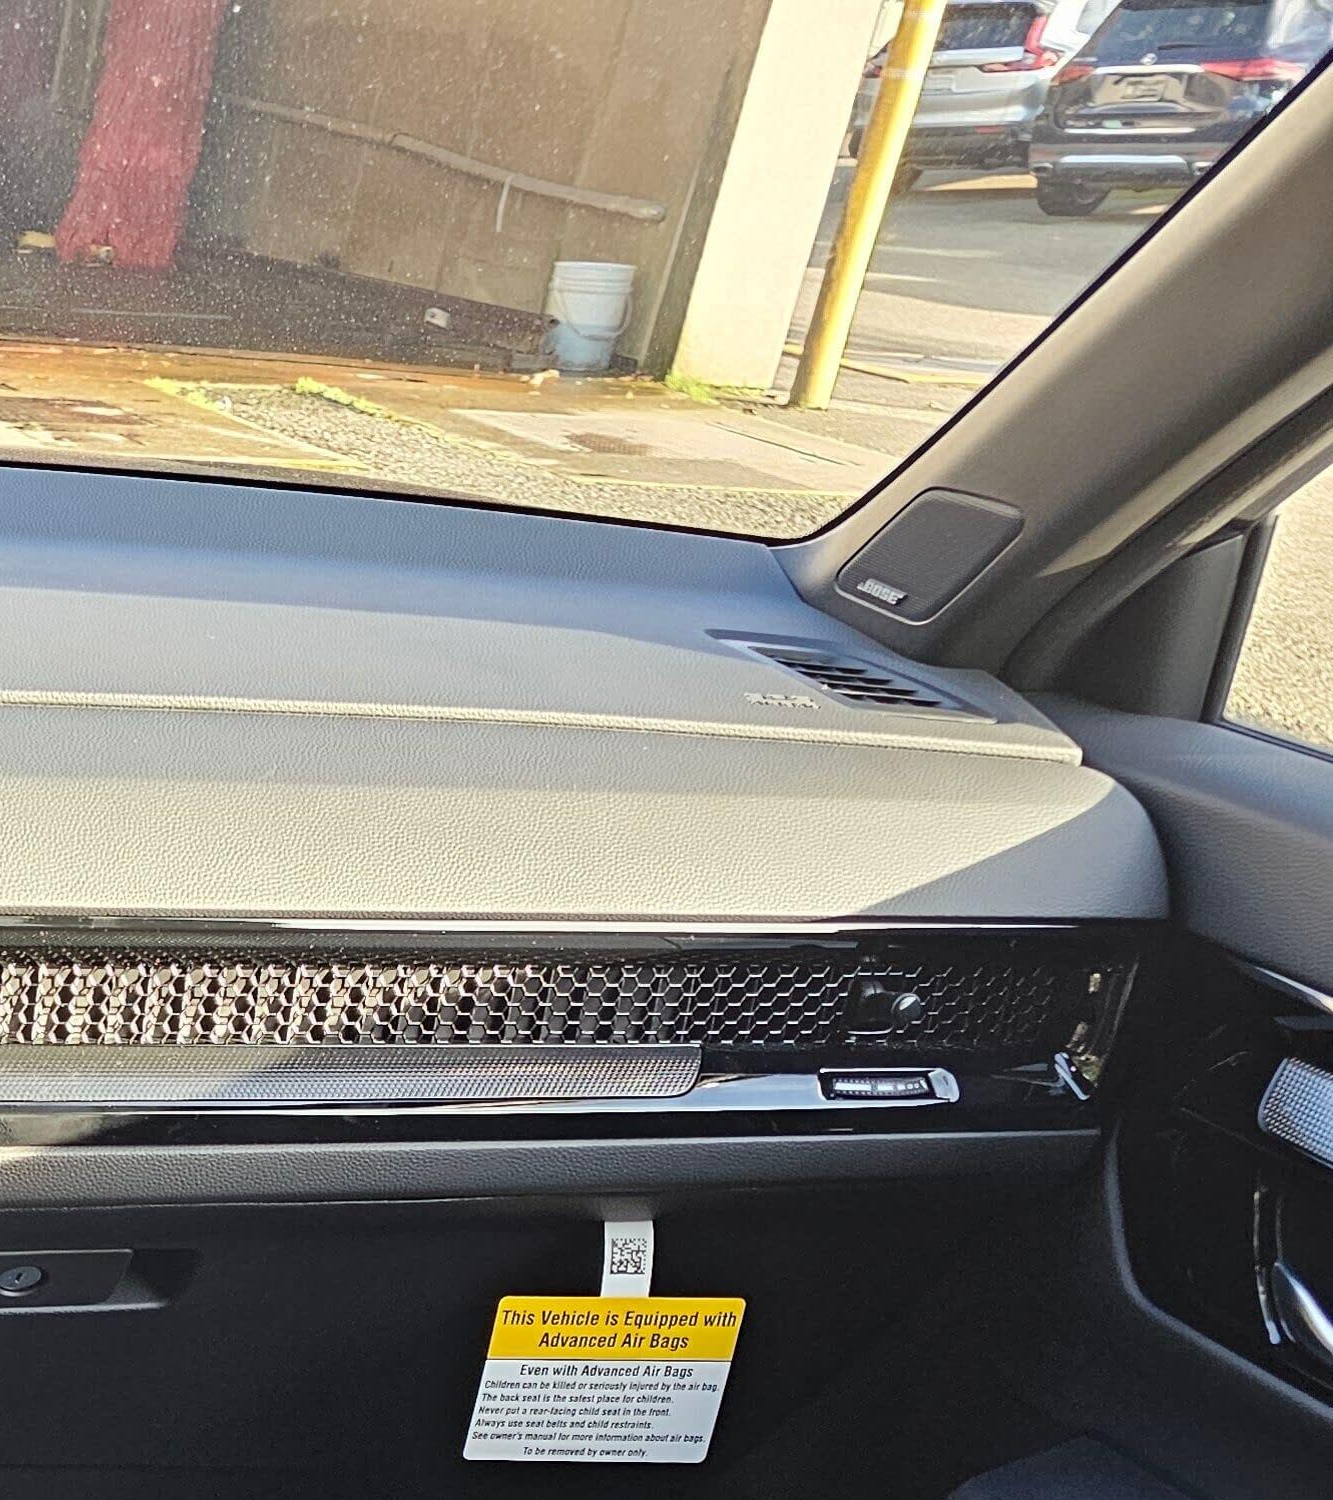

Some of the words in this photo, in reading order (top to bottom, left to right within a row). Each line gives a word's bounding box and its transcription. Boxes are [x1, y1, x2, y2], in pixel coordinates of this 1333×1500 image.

[502, 1310, 535, 1326] This
[541, 1310, 600, 1327] Vehicle
[604, 1311, 619, 1327] is
[624, 1311, 699, 1330] Equipped
[703, 1312, 737, 1328] with
[538, 1332, 618, 1349] Advanced
[621, 1333, 646, 1348] Air
[649, 1333, 690, 1352] Bags
[520, 1364, 549, 1377] Even
[552, 1364, 578, 1377] with
[580, 1365, 640, 1378] Advanced
[643, 1366, 661, 1378] Air
[664, 1366, 694, 1380] Bags
[484, 1380, 521, 1390] Children
[522, 1381, 538, 1390] can
[539, 1381, 551, 1390] be
[552, 1381, 577, 1391] killed
[577, 1382, 588, 1390] or
[588, 1382, 628, 1392] seriously
[629, 1382, 660, 1392] injured
[661, 1382, 672, 1393] by
[673, 1382, 687, 1392] the
[687, 1383, 700, 1392] air
[482, 1393, 498, 1402] The
[499, 1393, 520, 1402] back
[522, 1394, 541, 1402] seat
[542, 1394, 552, 1403] is
[553, 1394, 567, 1403] the
[569, 1394, 595, 1403] safest
[596, 1395, 621, 1405] place
[622, 1395, 635, 1404] for
[478, 1406, 504, 1416] Never
[505, 1407, 520, 1417] put
[529, 1407, 577, 1417] rear-facing
[578, 1407, 600, 1416] child
[601, 1408, 621, 1417] seat
[622, 1408, 632, 1417] in
[633, 1408, 648, 1417] the
[474, 1419, 506, 1429] Always
[525, 1420, 545, 1429] seat
[546, 1420, 567, 1429] belts
[569, 1420, 586, 1429] and
[587, 1421, 609, 1429] child
[472, 1431, 488, 1440] See
[524, 1433, 557, 1441] manual
[558, 1433, 571, 1441] for
[595, 1433, 644, 1442] information
[644, 1434, 669, 1442] about
[670, 1434, 683, 1443] air
[523, 1447, 533, 1456] To
[534, 1447, 546, 1456] be
[547, 1447, 586, 1457] removed
[587, 1448, 598, 1458] by
[598, 1449, 626, 1457] owner
